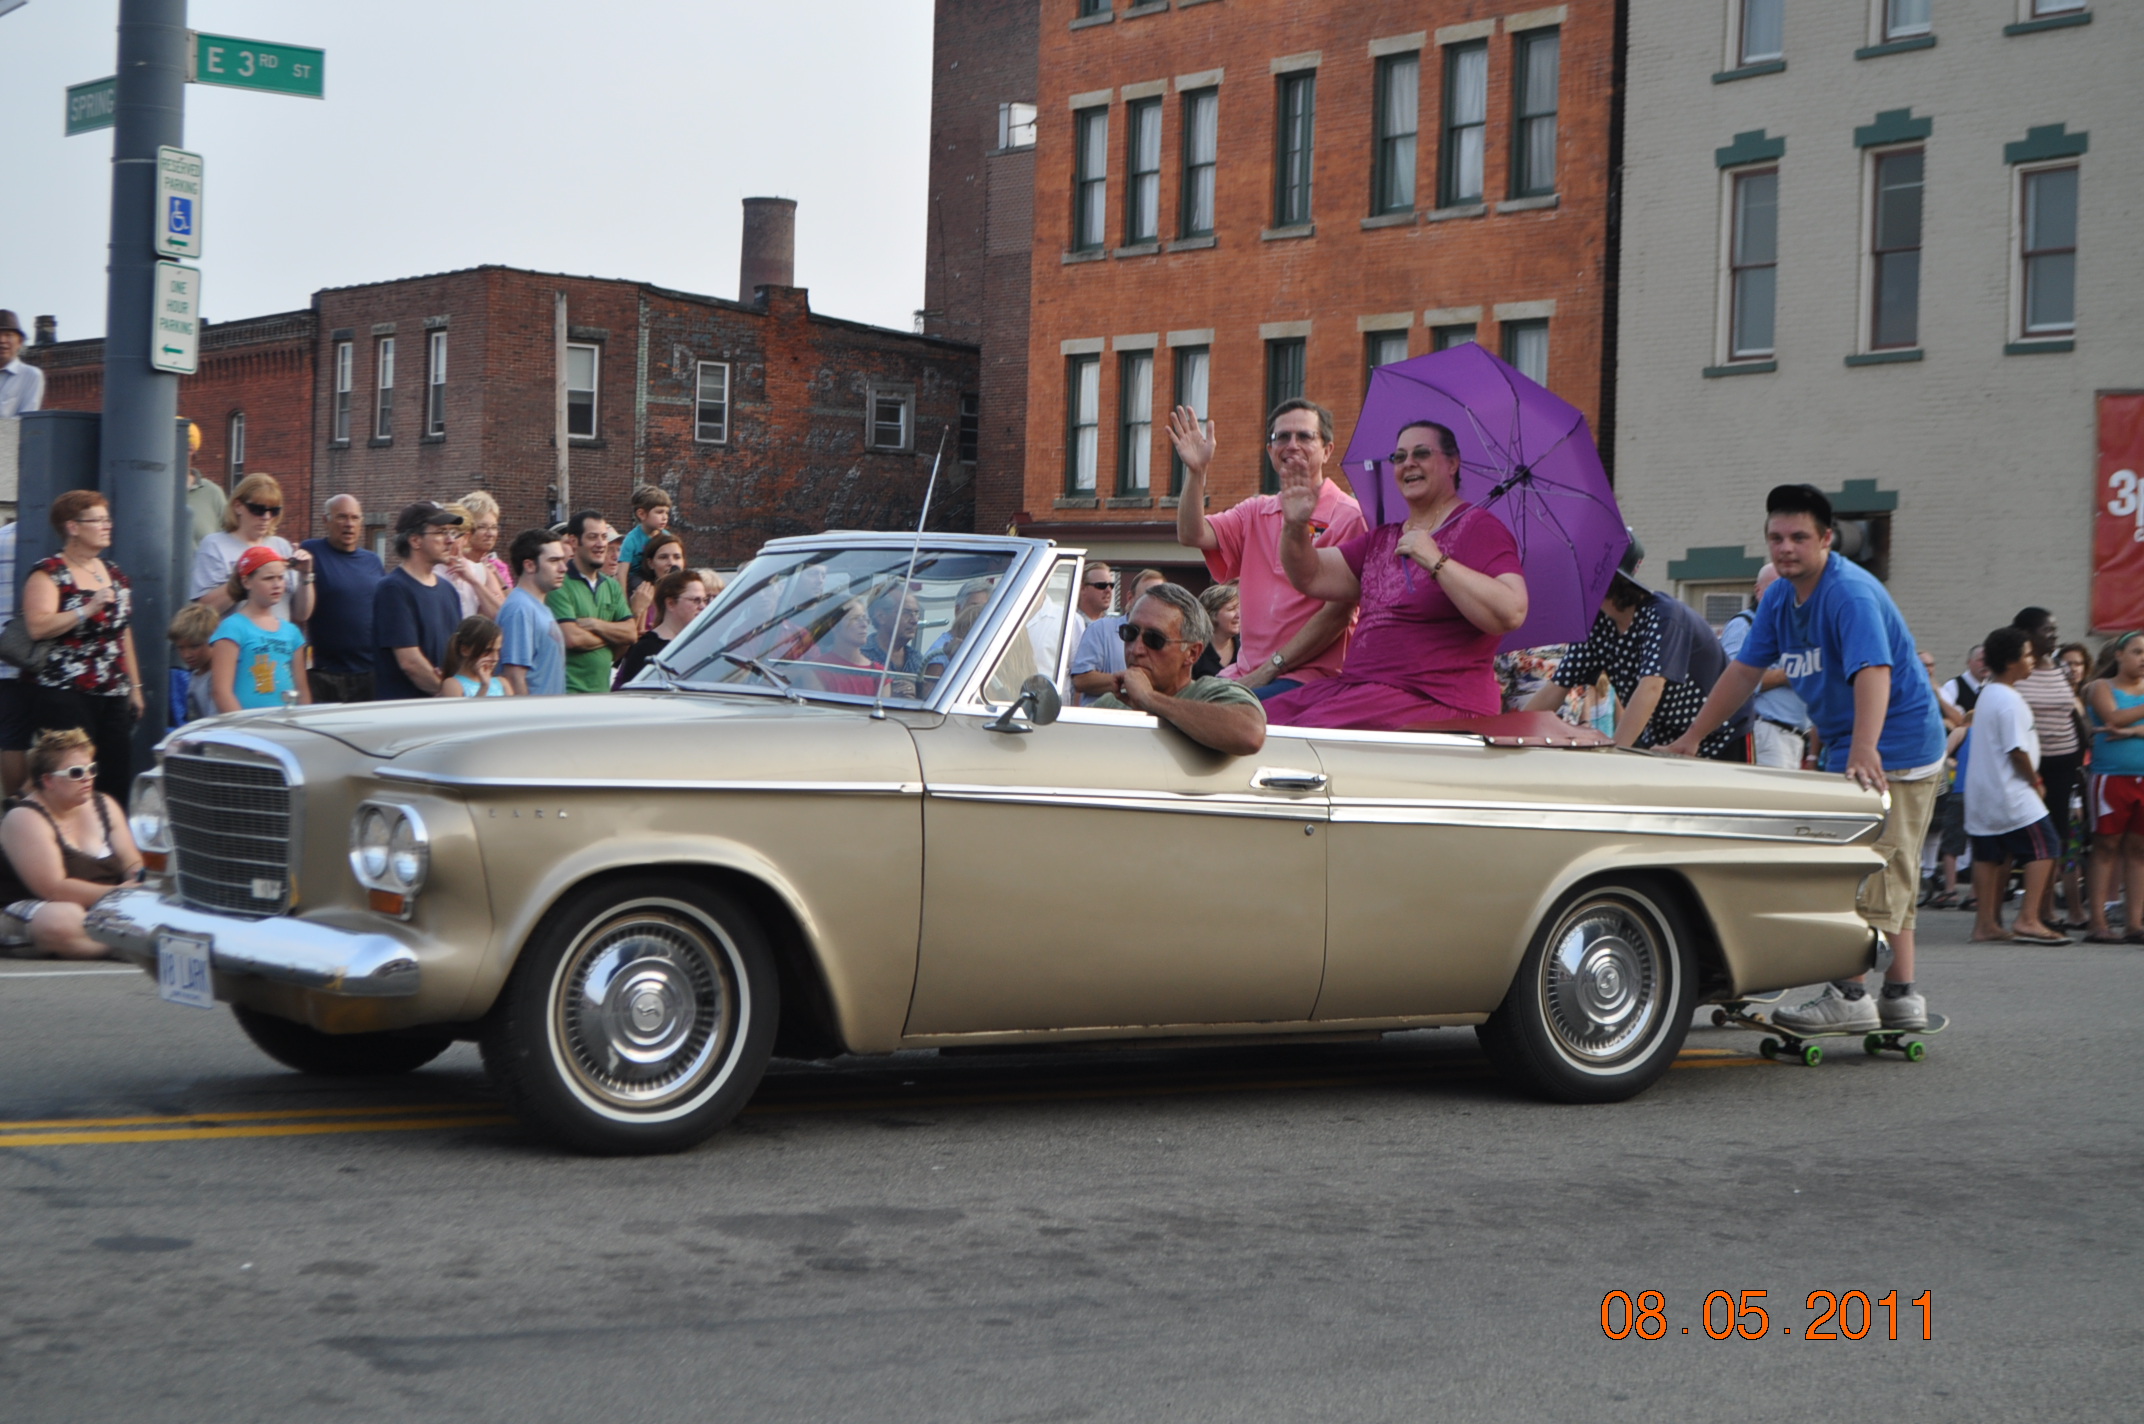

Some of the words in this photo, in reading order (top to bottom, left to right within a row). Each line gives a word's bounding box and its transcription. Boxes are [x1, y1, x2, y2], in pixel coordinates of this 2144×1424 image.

[207, 46, 225, 74] E
[237, 51, 278, 77] 3RD
[292, 63, 312, 79] ST
[71, 88, 115, 122] SPRING
[160, 157, 201, 177] RESERVED
[164, 176, 198, 195] PARKING
[170, 280, 187, 295] ONE
[166, 299, 189, 314] HOUR
[159, 317, 193, 335] PARKING
